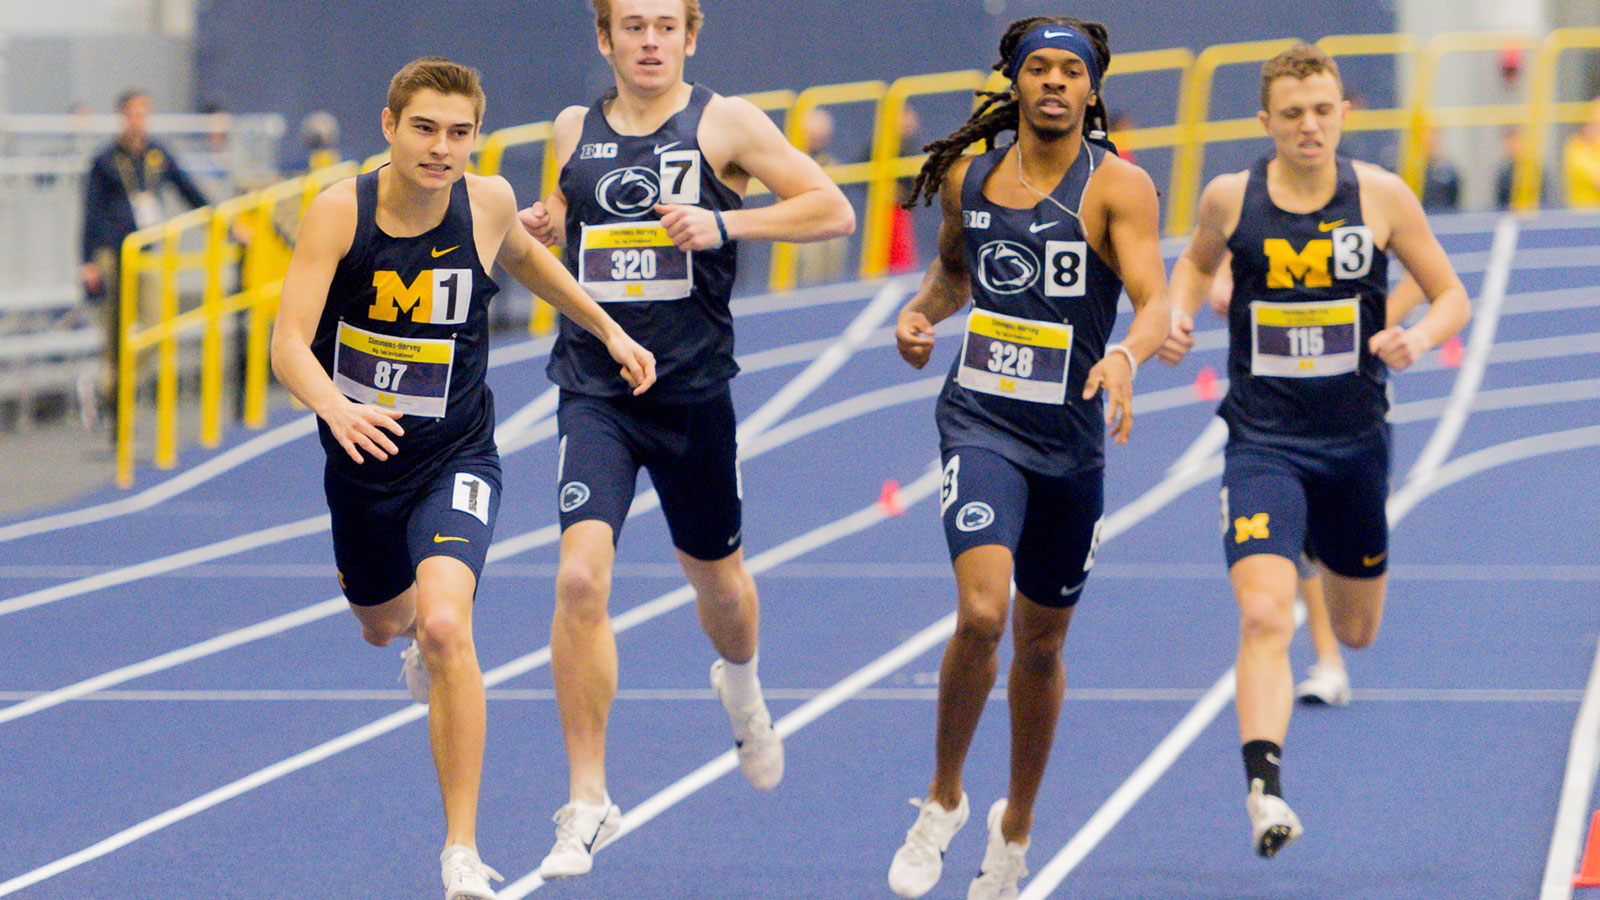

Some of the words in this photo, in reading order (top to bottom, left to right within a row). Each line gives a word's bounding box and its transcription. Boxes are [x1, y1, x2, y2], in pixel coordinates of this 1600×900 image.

[665, 160, 693, 195] 7
[611, 249, 657, 280] 320
[1052, 251, 1080, 287] 8
[1263, 238, 1333, 289] M
[1341, 232, 1365, 272] 3
[368, 269, 433, 324] M
[439, 273, 459, 321] 1
[987, 341, 1034, 378] 328
[1287, 327, 1325, 357] 115
[374, 361, 408, 392] 87
[462, 480, 480, 513] 1
[1234, 512, 1269, 544] M
